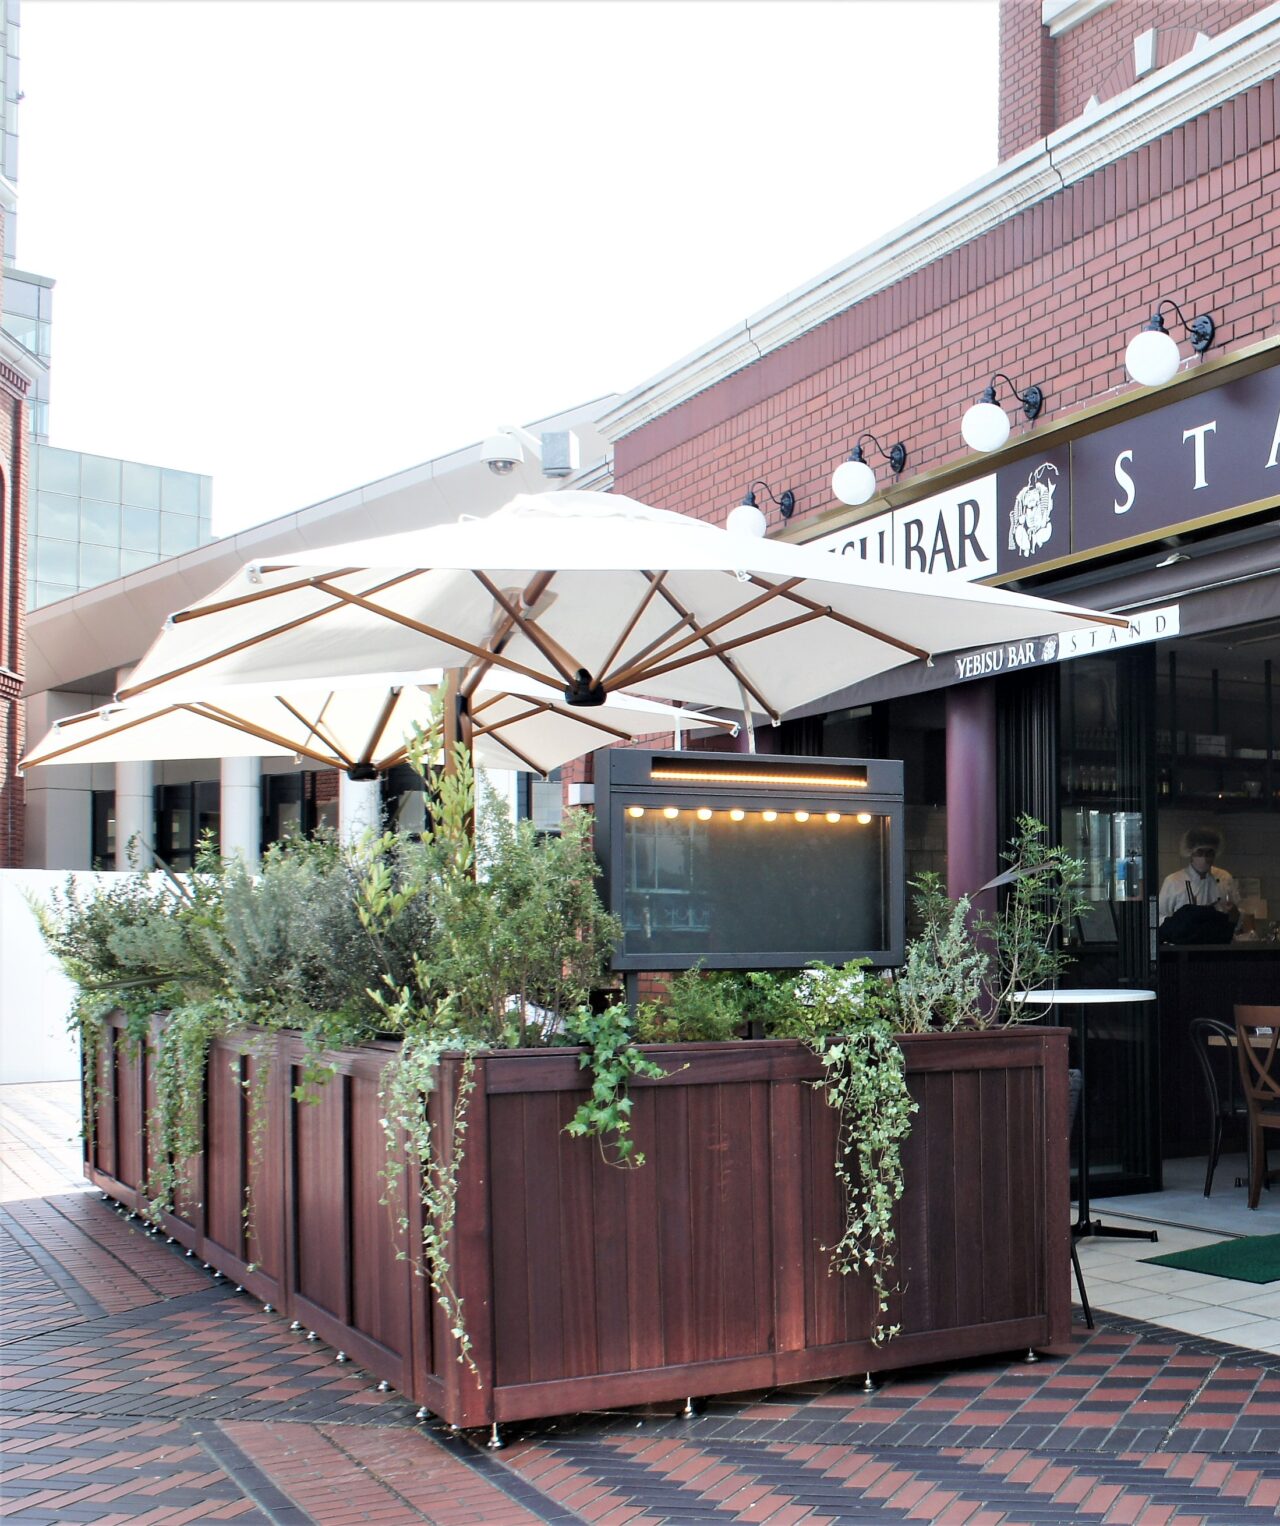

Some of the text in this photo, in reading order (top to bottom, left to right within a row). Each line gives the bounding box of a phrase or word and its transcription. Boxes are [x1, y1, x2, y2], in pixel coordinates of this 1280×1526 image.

[904, 498, 990, 575] BAR
[956, 615, 1167, 679] YEBISU BAR STAND
